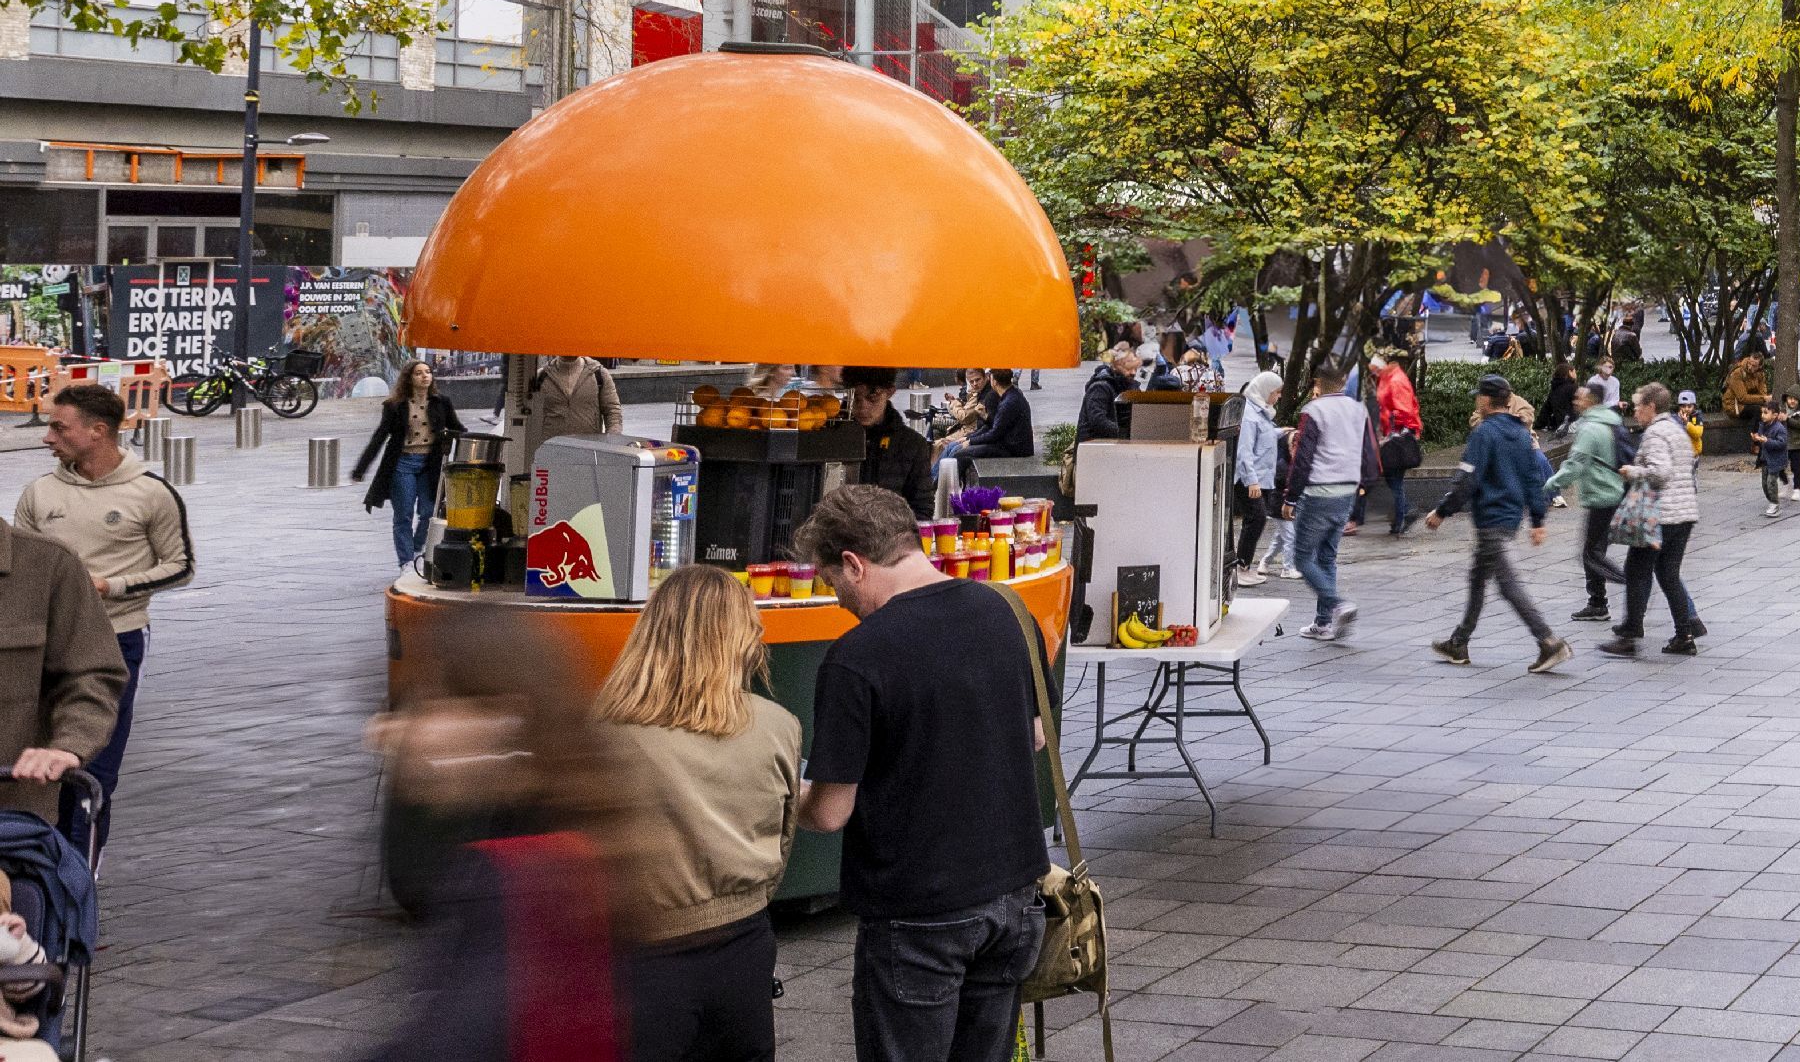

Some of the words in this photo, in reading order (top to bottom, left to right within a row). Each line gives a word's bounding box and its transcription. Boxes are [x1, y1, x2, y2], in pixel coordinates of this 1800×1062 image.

[314, 281, 330, 290] VAN
[331, 281, 364, 290] EESTEREN
[300, 293, 332, 302] BOUWDE
[333, 293, 342, 301] IN
[298, 305, 318, 313] OOK
[318, 305, 330, 313] DIT
[330, 305, 357, 313] ICOON.
[128, 311, 234, 333] ERVAREN?
[127, 336, 169, 358] DOE
[174, 335, 216, 356] HET
[535, 469, 549, 497] Bull
[534, 498, 548, 526] Red
